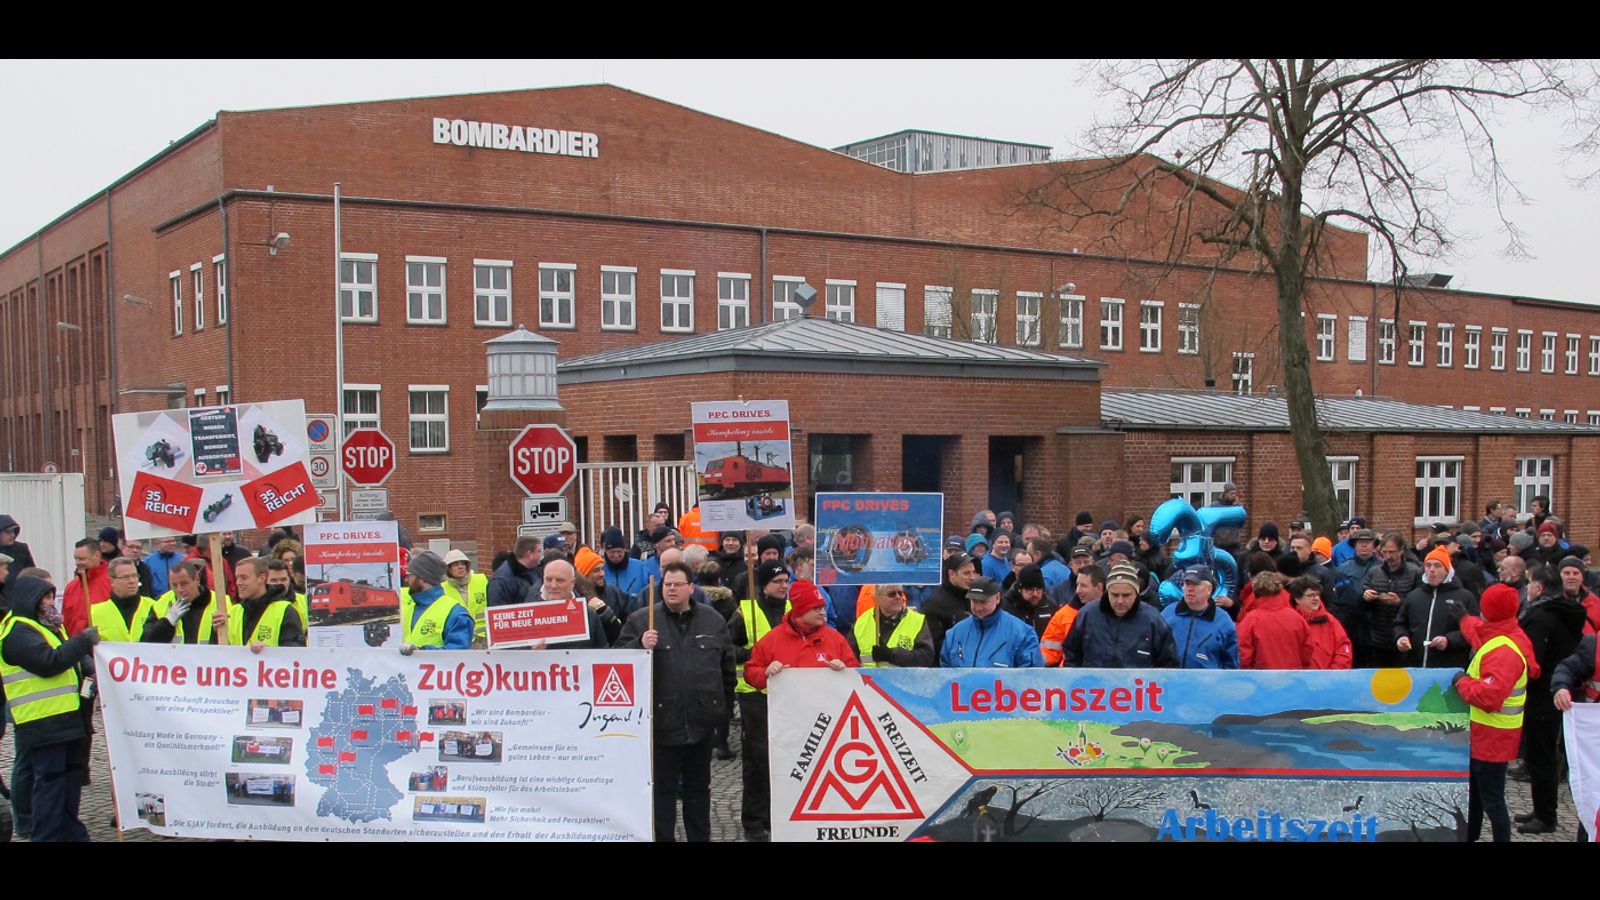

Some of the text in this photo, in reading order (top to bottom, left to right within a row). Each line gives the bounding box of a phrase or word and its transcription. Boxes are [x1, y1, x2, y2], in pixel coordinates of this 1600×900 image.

[433, 118, 599, 158] BOMBARDIER
[708, 410, 771, 419] PPC DRIVES
[707, 428, 750, 437] Kompetenz
[345, 446, 390, 468] STOP
[517, 447, 570, 475] STOP
[313, 462, 324, 471] 30
[146, 490, 161, 500] 35
[260, 489, 276, 504] 35
[266, 483, 306, 513] REICHT
[145, 502, 191, 517] REICHT
[822, 500, 910, 511] PPC DRIVES
[320, 531, 380, 540] PPC DRIVES
[319, 550, 361, 559] Kompetenz
[493, 609, 535, 620] KEINE ZEIT
[493, 615, 568, 630] FÜR NEUE MAUERN
[108, 656, 337, 689] Ohne uns keine
[417, 662, 581, 697] Zu(g)kunft!
[173, 695, 204, 704] Zukunft
[204, 697, 240, 705] brauchen
[950, 678, 1164, 712] Lebenszeit
[168, 705, 186, 713] eine
[505, 709, 546, 717] Bombardier
[156, 731, 175, 739] Made
[175, 731, 183, 739] in
[184, 732, 218, 742] Germany
[144, 741, 156, 749] ein
[554, 744, 567, 752] für
[790, 712, 832, 782] FAMILIE
[877, 711, 928, 784] FREIZEIT
[508, 754, 528, 762] gutes
[529, 753, 551, 761] Leben
[160, 768, 198, 778] Ausbildung
[199, 770, 217, 778] stirbt
[518, 775, 529, 783] ist
[546, 776, 575, 784] wichtige
[576, 776, 614, 784] Grundlage
[507, 806, 519, 814] für
[520, 806, 541, 814] mehr!
[490, 815, 508, 823] Mehr
[509, 815, 547, 823] Sicherheit
[1157, 807, 1378, 842] Arbeitszeit
[186, 820, 205, 828] GJAV
[206, 821, 234, 829] fordert,
[235, 821, 247, 829] die
[249, 823, 291, 833] Ausbildung
[320, 826, 361, 834] deutschen
[362, 827, 407, 836] Standorten
[408, 828, 470, 837] sicherzustellen
[490, 831, 505, 839] den
[507, 831, 532, 839] Erhalt
[816, 826, 900, 840] FREUNDE
